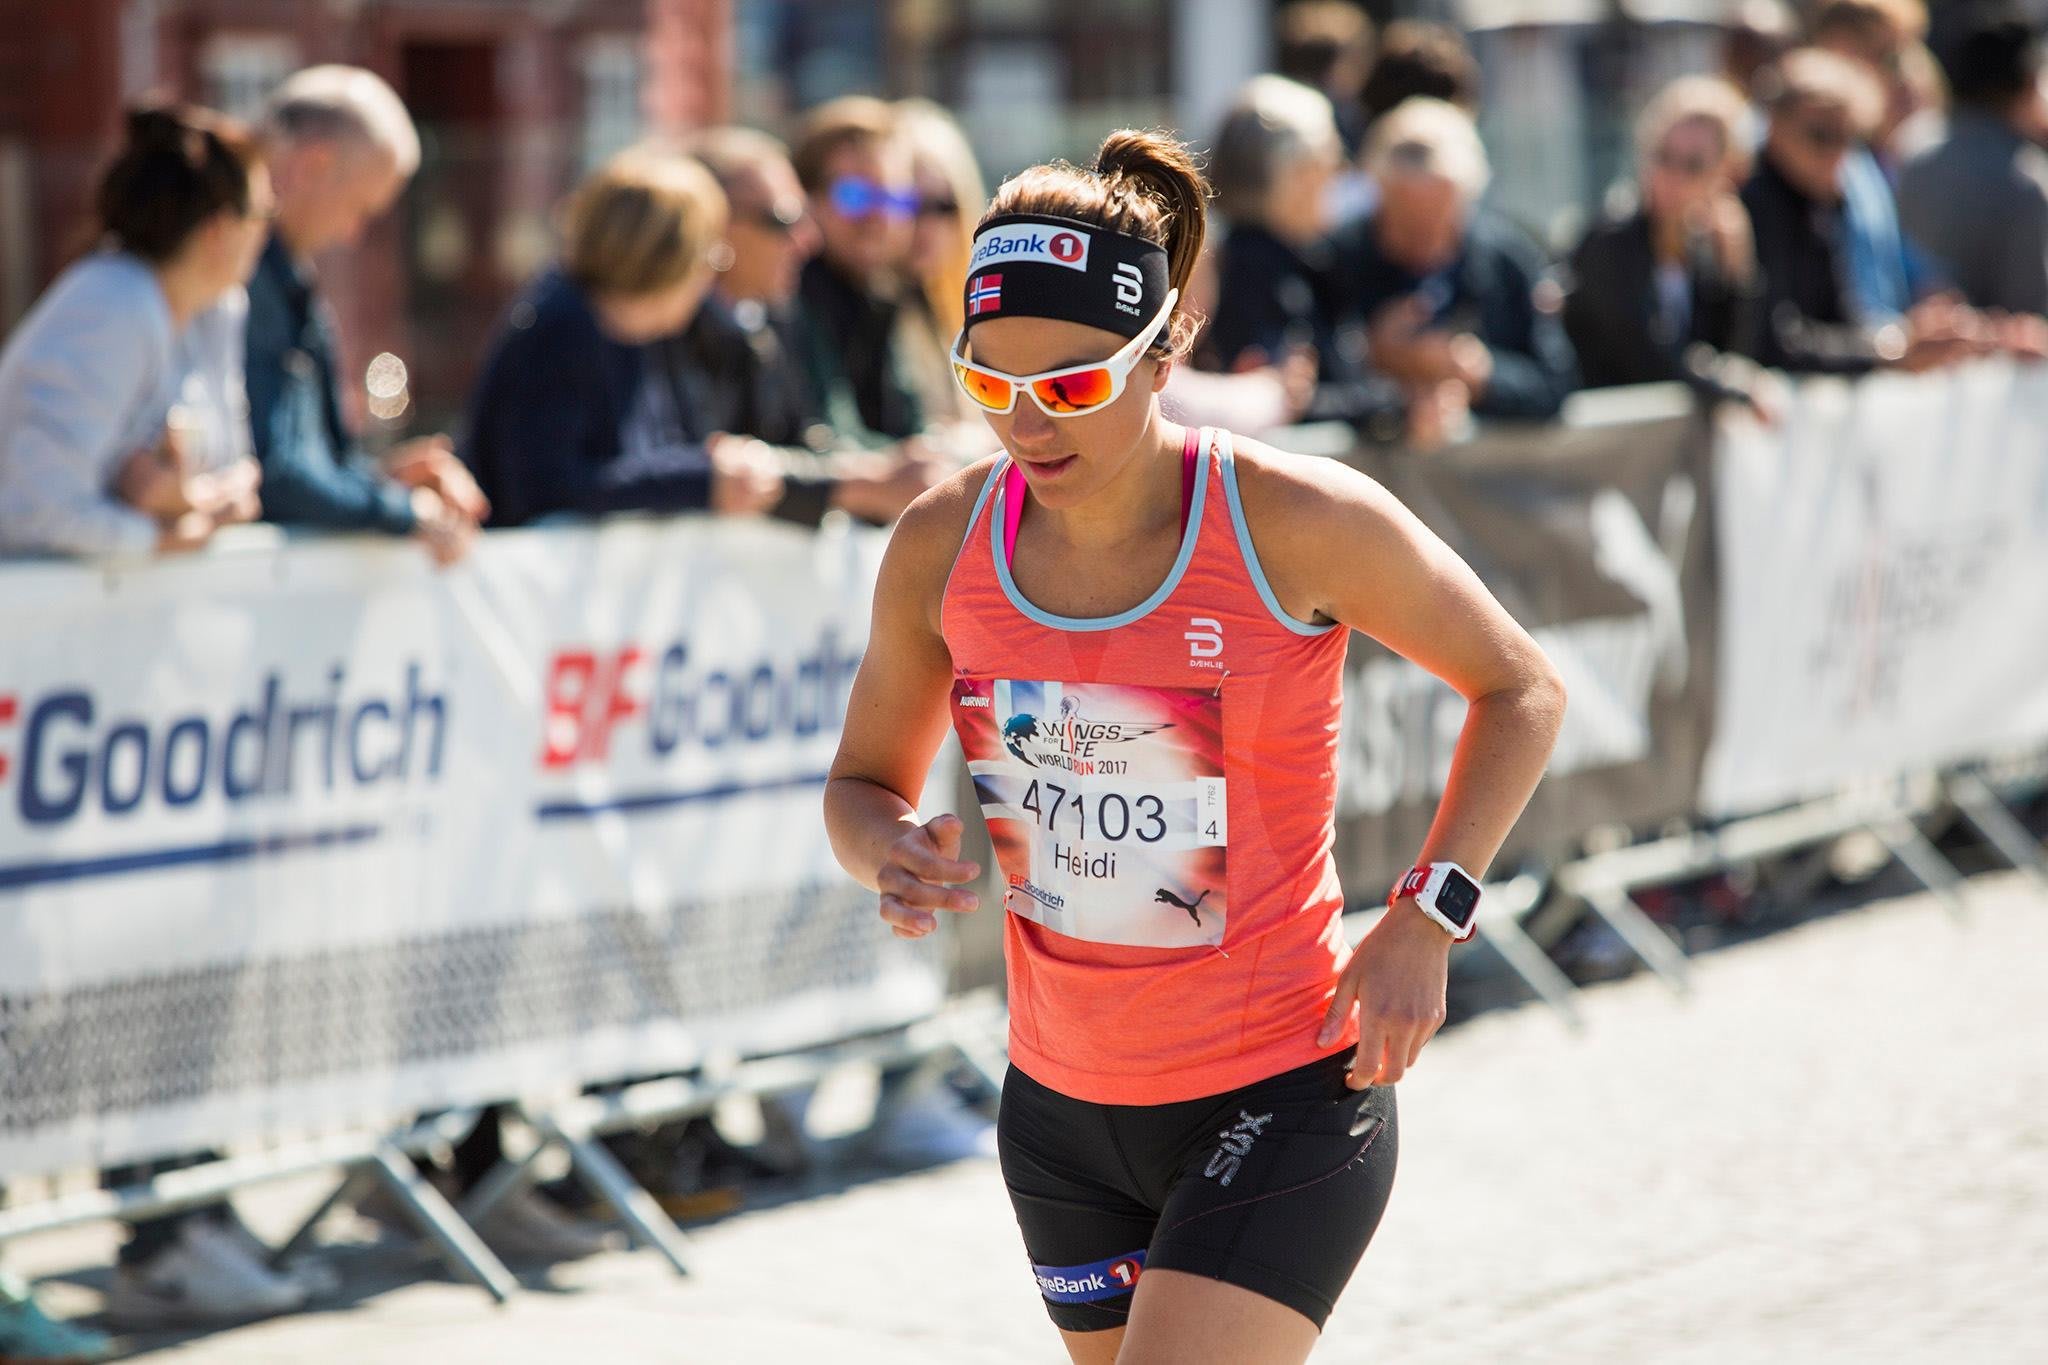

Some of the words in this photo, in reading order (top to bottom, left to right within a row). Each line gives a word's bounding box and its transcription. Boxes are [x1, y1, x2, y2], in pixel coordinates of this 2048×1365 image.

[1042, 716, 1122, 740] WINGS
[1043, 737, 1060, 745] FOR
[1098, 760, 1128, 775] 2017
[1022, 779, 1168, 843] 47103
[1205, 820, 1220, 840] 4
[1054, 843, 1117, 879] Heidi
[1009, 873, 1065, 908] BFGoodrich
